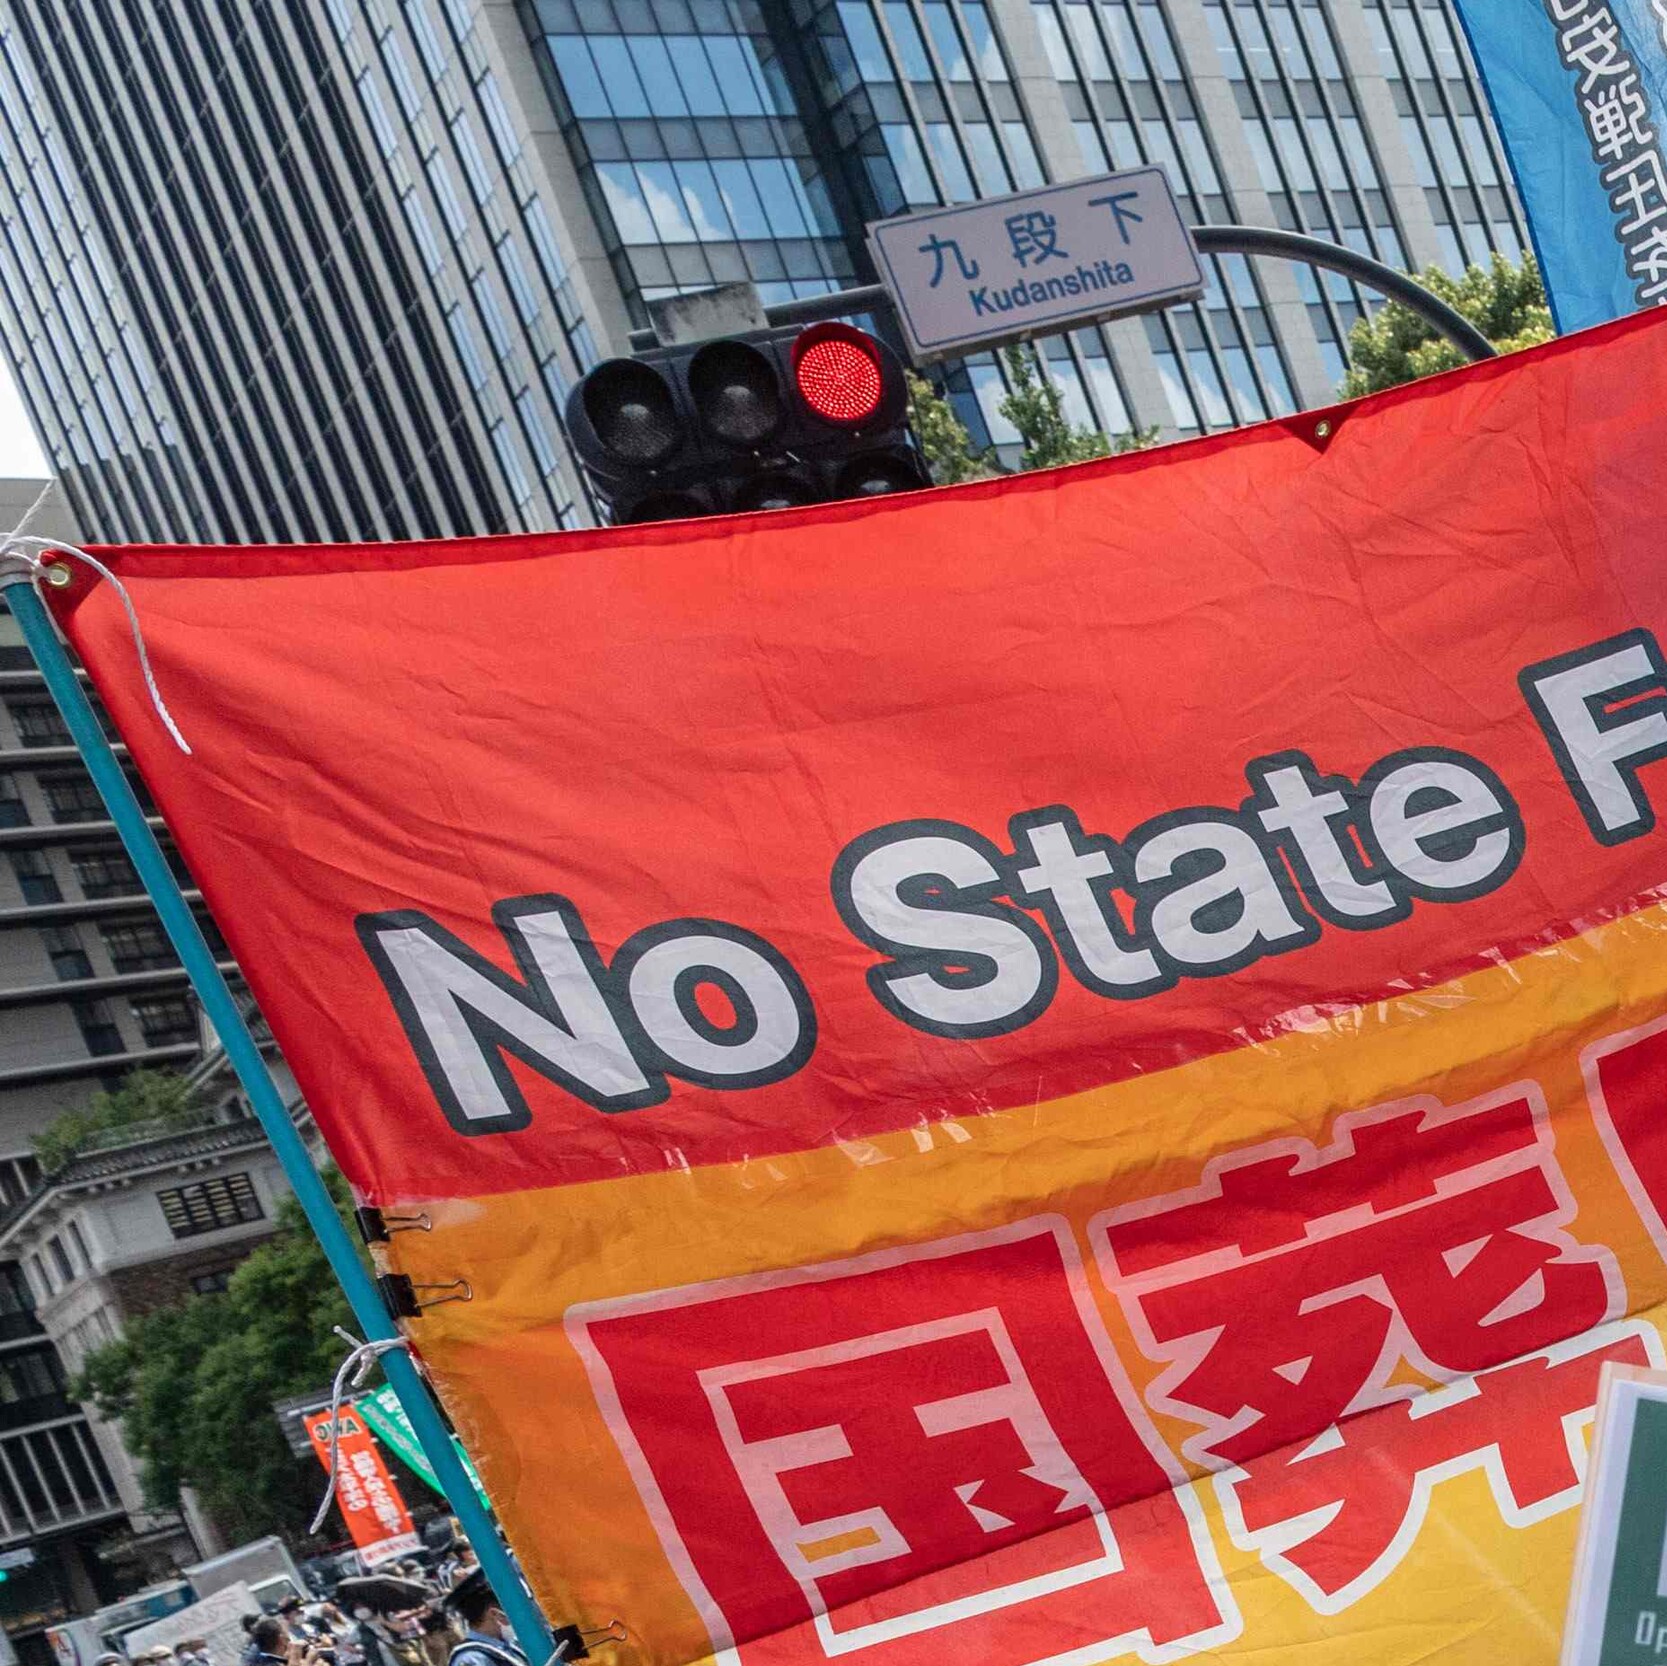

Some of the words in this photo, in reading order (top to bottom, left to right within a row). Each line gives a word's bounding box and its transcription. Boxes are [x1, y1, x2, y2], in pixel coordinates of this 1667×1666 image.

[918, 191, 1143, 288] 九段下
[968, 260, 1135, 316] Kudanshita
[360, 897, 814, 1133] No
[830, 744, 1526, 1039] State
